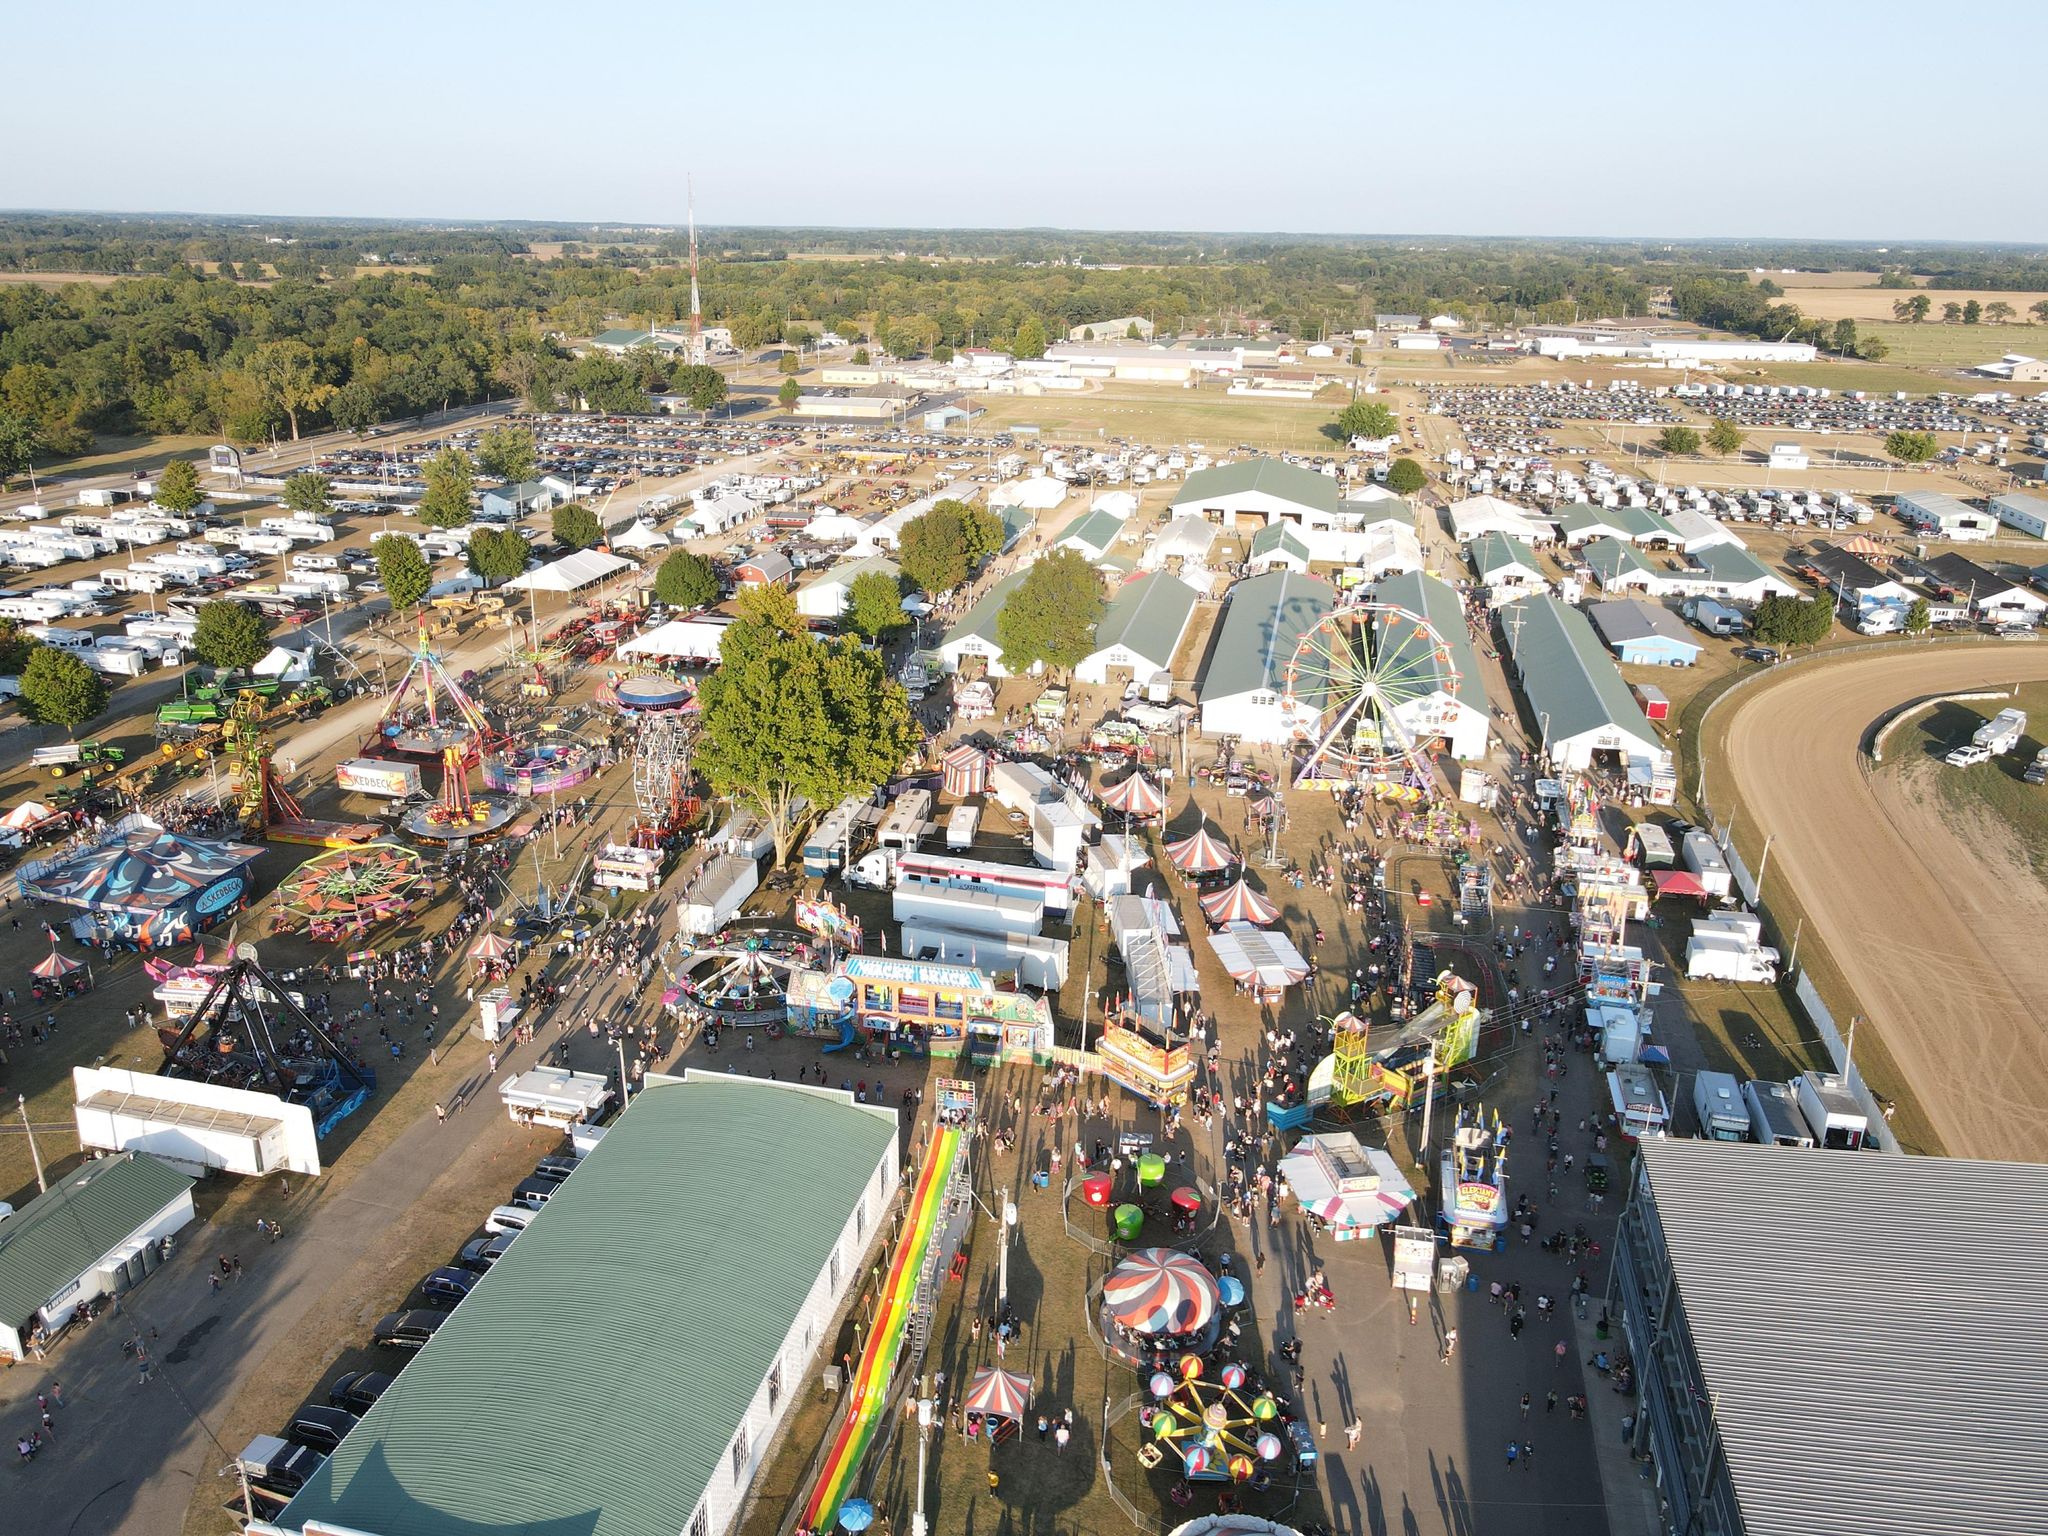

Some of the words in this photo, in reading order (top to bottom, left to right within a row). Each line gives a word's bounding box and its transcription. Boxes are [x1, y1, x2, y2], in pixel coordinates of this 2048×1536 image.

[340, 774, 398, 792] SKERBECK
[205, 879, 242, 907] SKERBECK
[1461, 1186, 1496, 1198] ELEPHANT
[1397, 1245, 1432, 1258] ICKETS
[51, 1283, 78, 1308] WOMEN
